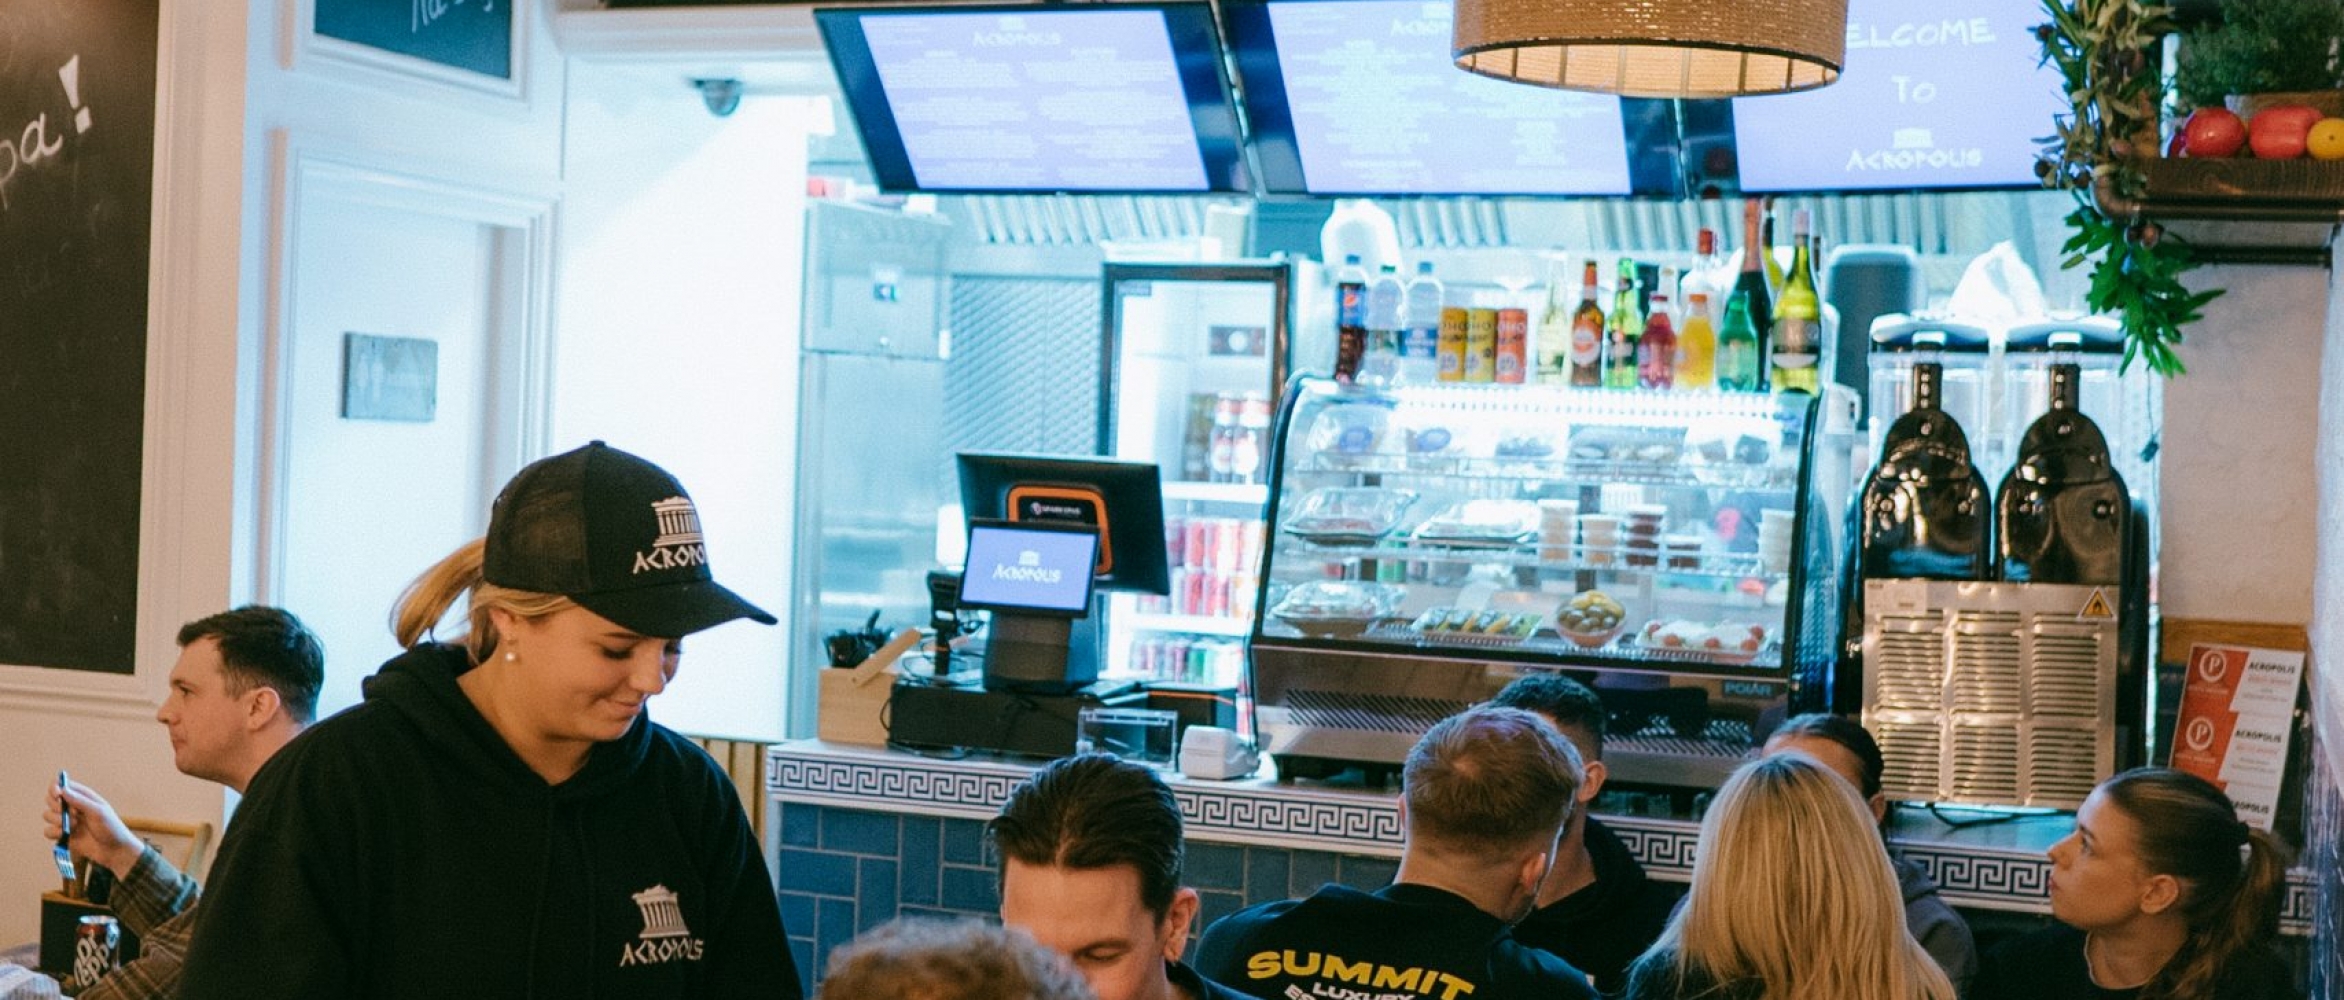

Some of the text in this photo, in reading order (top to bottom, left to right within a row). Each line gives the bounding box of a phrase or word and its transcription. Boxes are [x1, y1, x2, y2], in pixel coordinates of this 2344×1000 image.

[1846, 17, 1997, 49] ELCOME
[1846, 148, 1983, 172] ACROPOLIS
[632, 543, 706, 575] ACROPO
[992, 563, 1061, 584] ACROPOLIS
[2249, 662, 2296, 675] ACROPOLIS
[2235, 729, 2282, 744] ACROPOLIS
[619, 937, 704, 968] ACROPOLS
[1246, 949, 1476, 1000] SUMMIT
